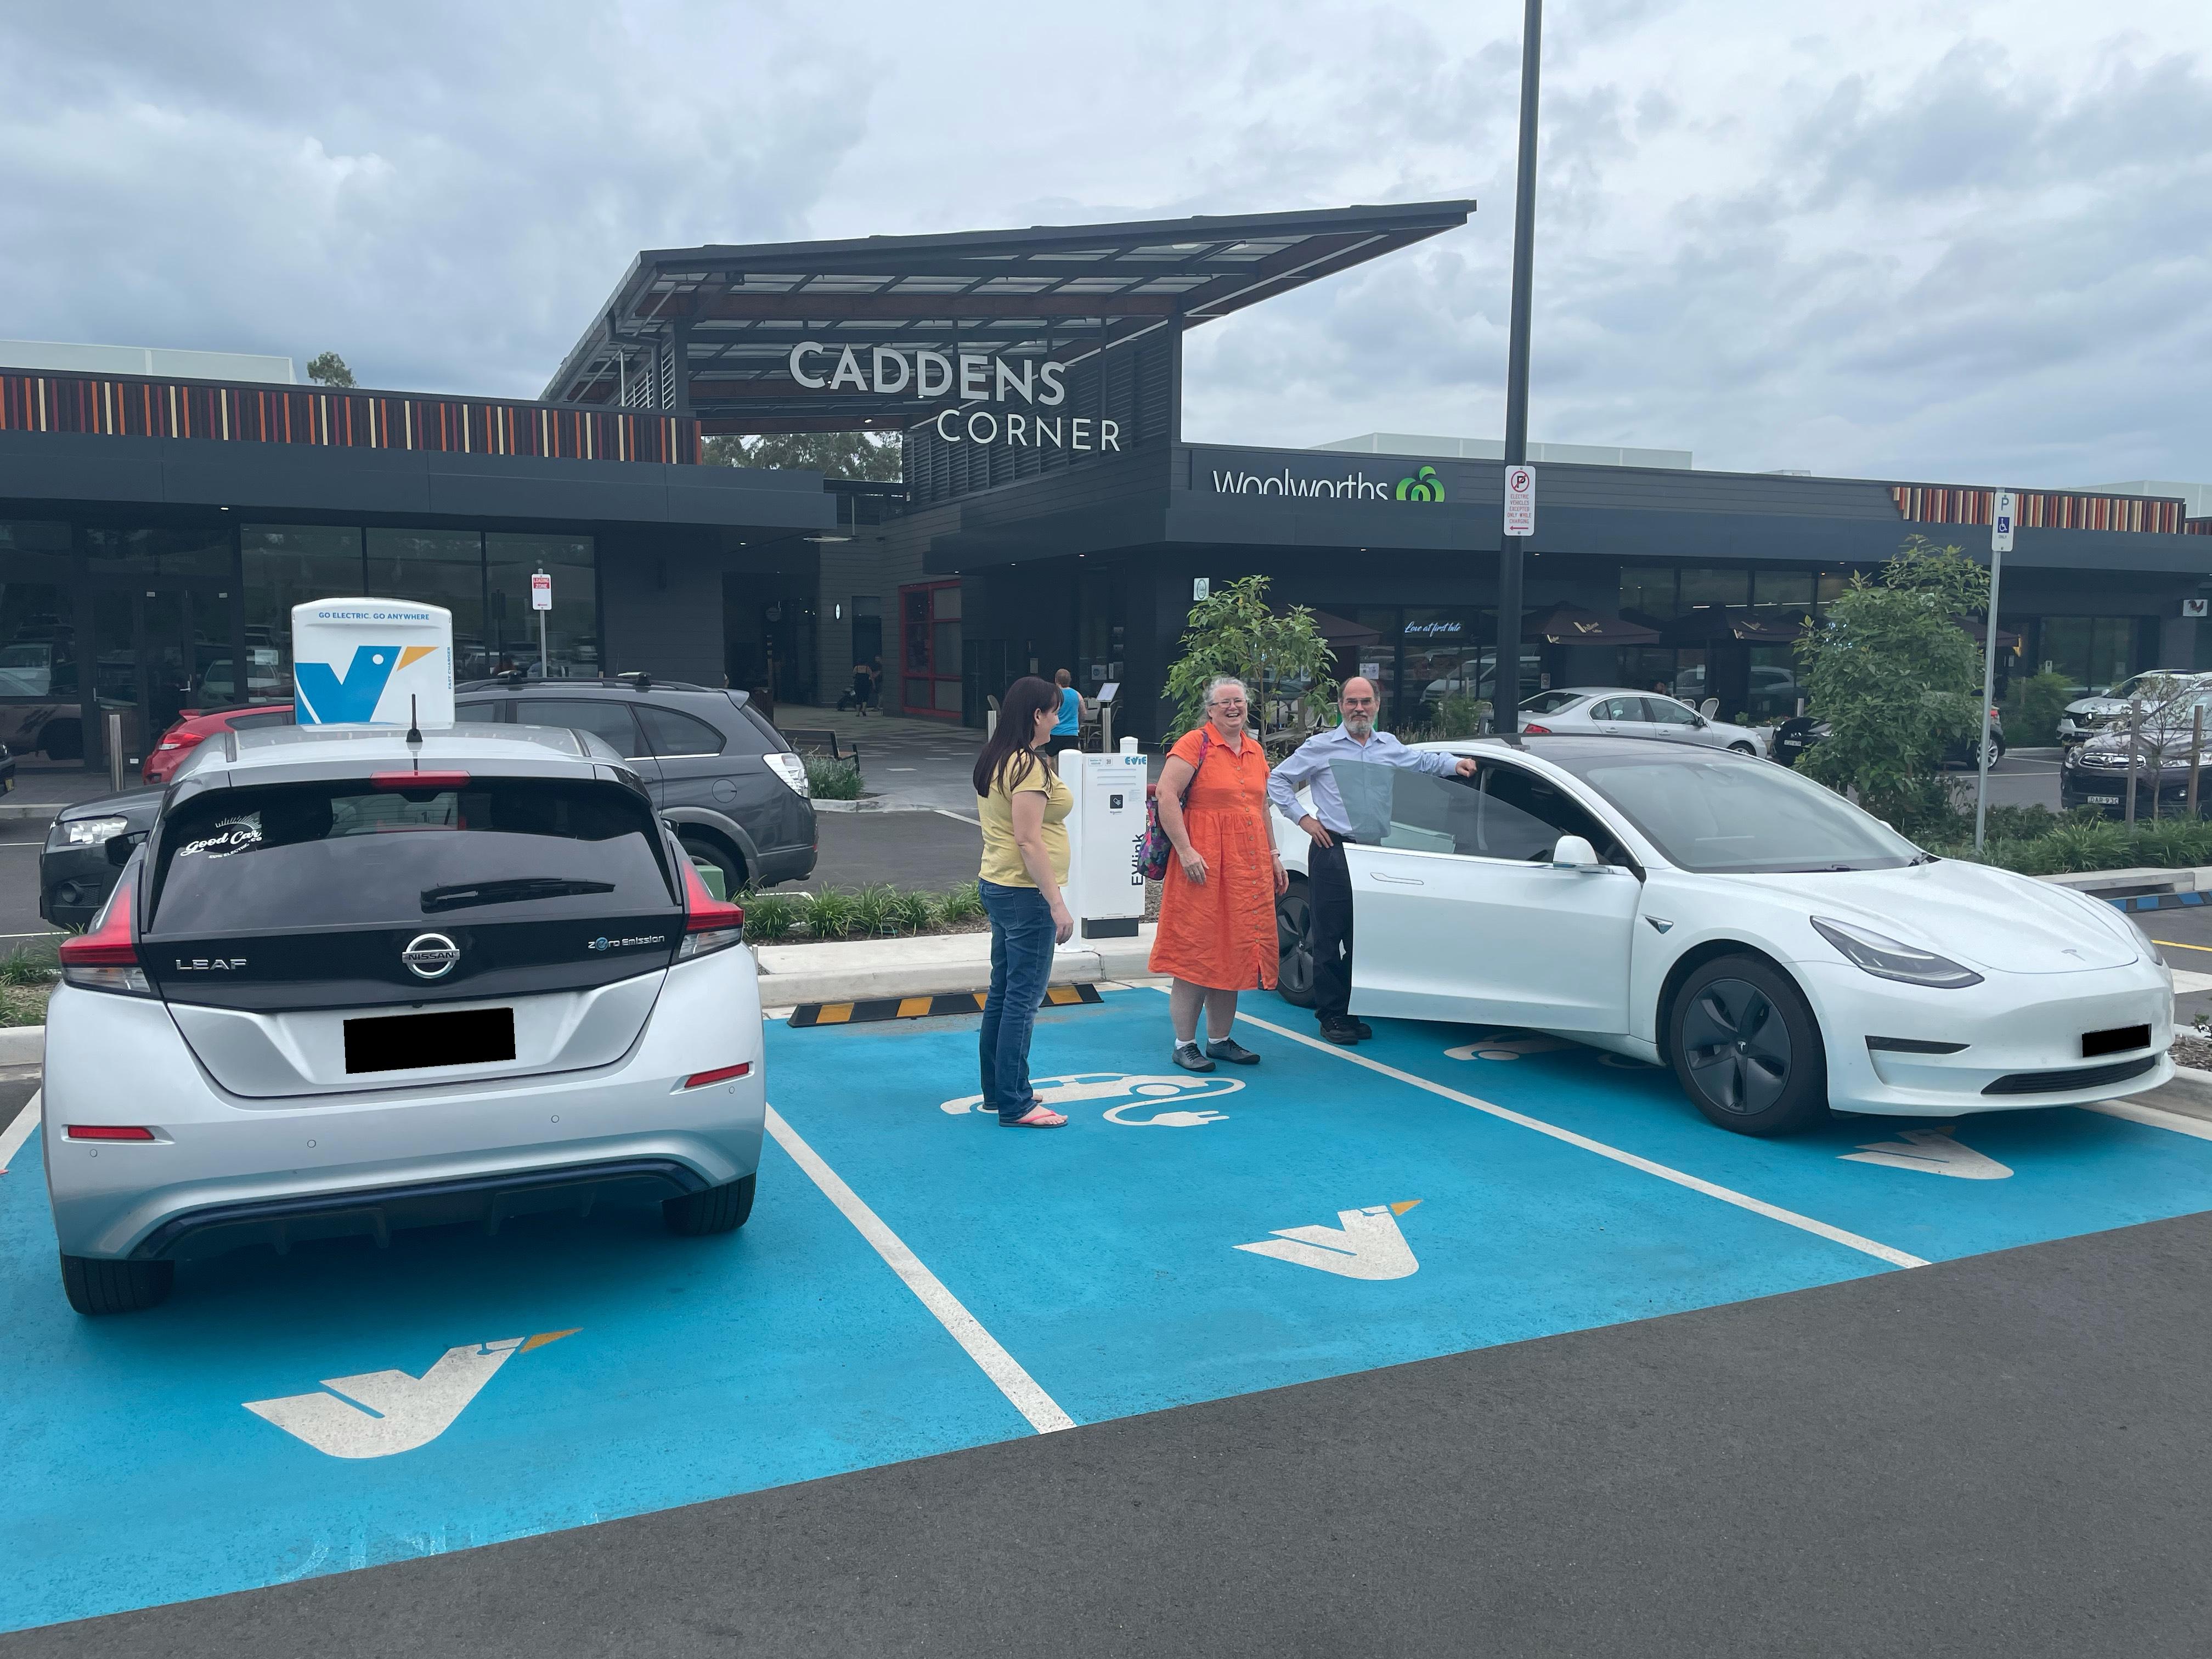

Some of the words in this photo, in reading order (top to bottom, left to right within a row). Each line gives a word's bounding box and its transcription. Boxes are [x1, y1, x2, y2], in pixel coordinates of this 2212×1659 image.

[789, 341, 1066, 405] CADDENS
[937, 409, 1120, 452] CORNER
[1213, 469, 1388, 500] Woolworths
[180, 832, 229, 856] Good
[230, 830, 262, 845] Car
[223, 843, 250, 857] ELECTRIC
[622, 935, 665, 946] Emission
[176, 959, 247, 970] LEAF
[409, 952, 454, 960] NISSAN
